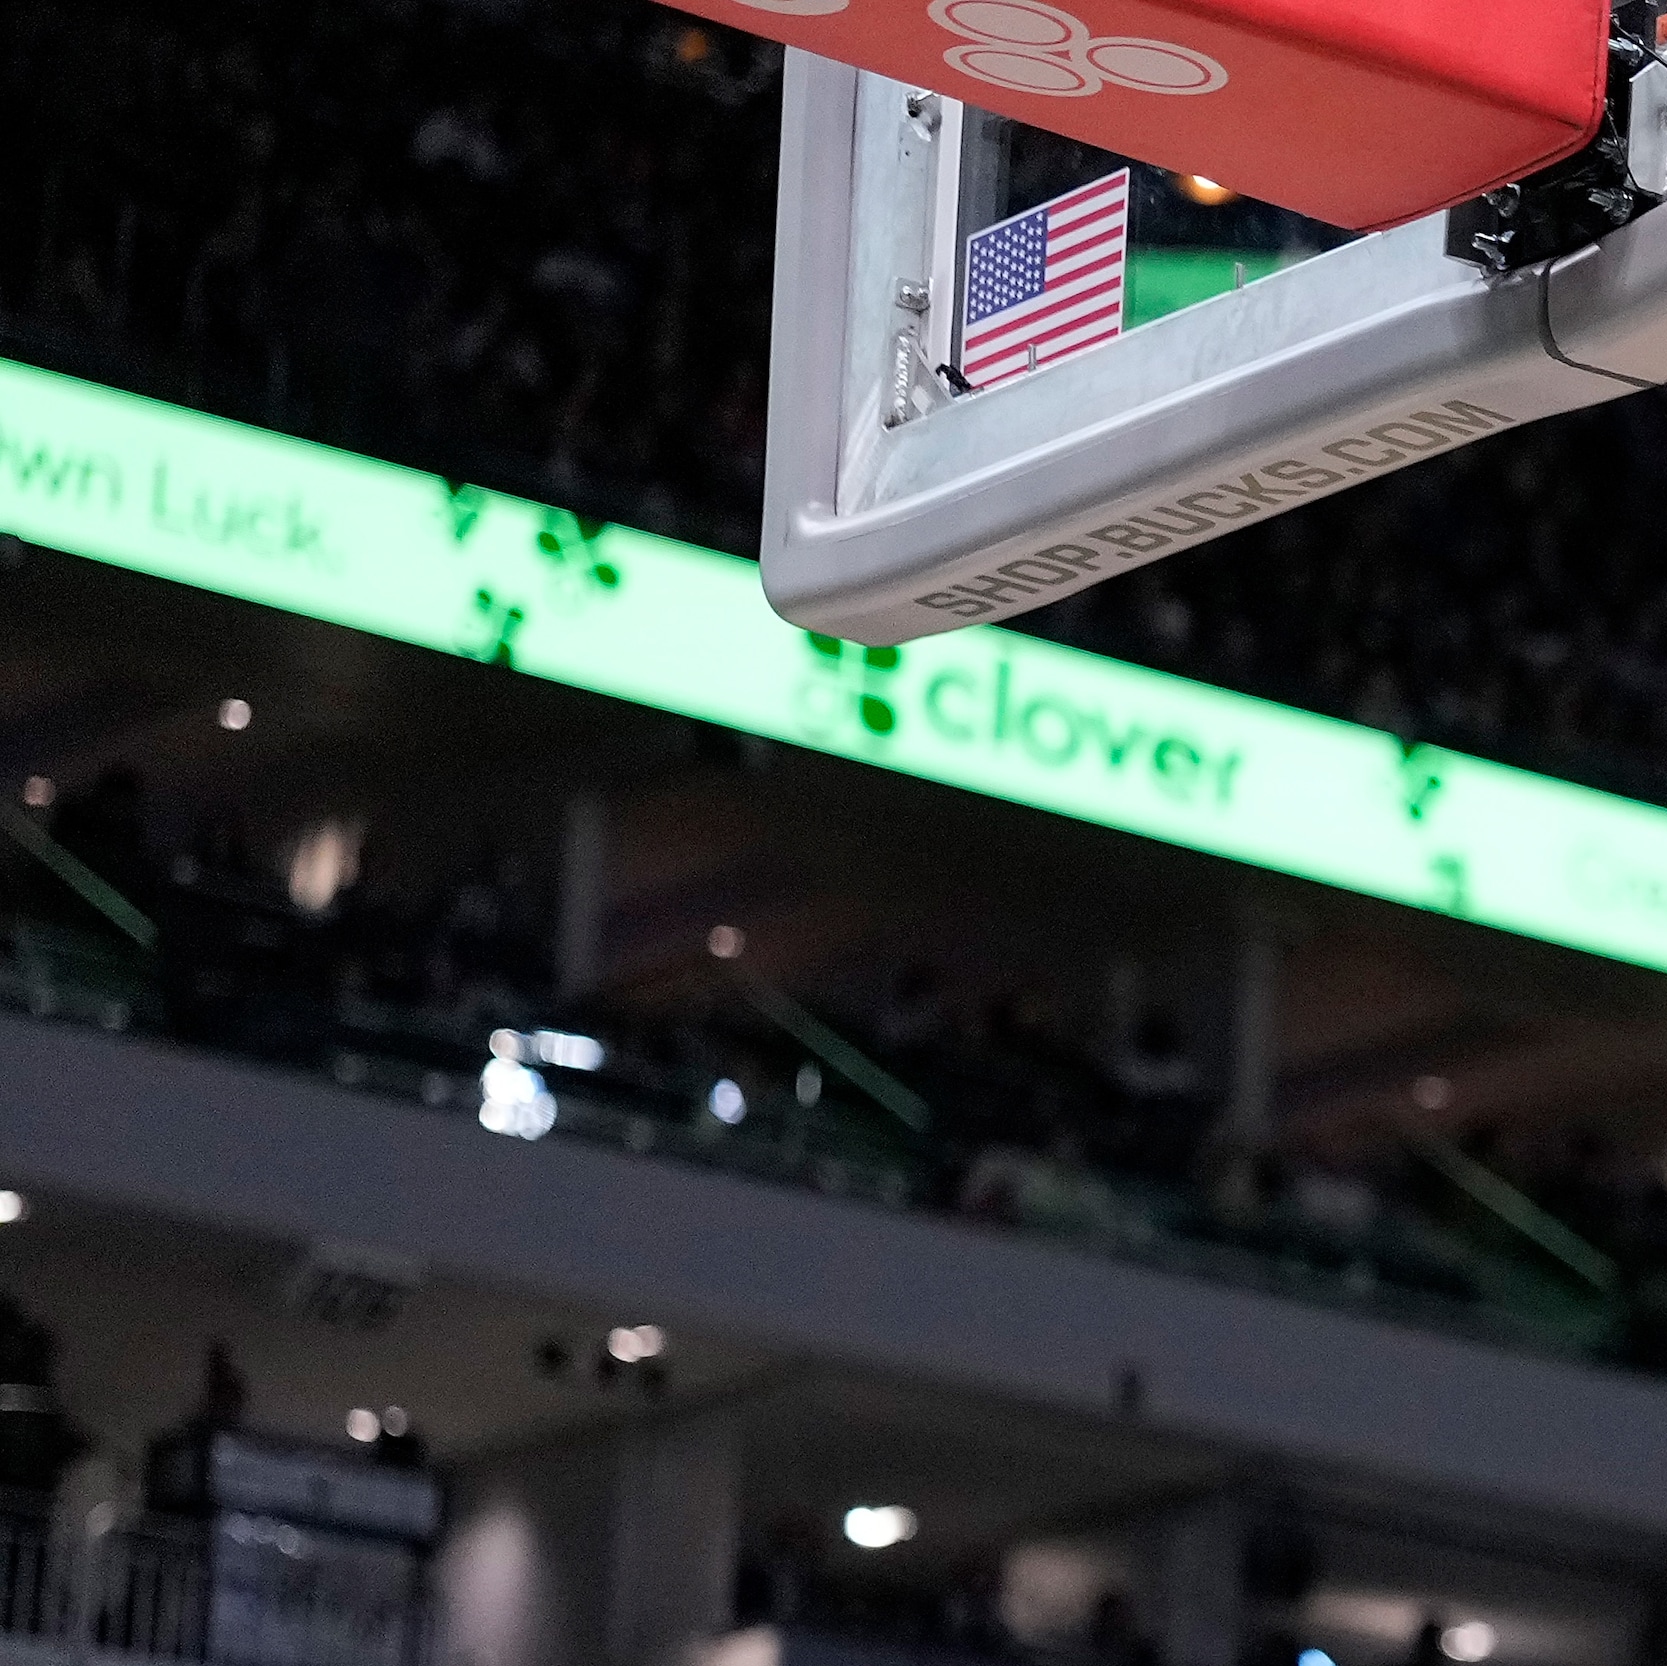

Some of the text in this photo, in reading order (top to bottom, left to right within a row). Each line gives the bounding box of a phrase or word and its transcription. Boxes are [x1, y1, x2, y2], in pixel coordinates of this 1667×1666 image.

[0, 428, 123, 512] wn
[914, 399, 1517, 618] SHOP.BUCKS.COM
[924, 660, 1245, 808] clover
